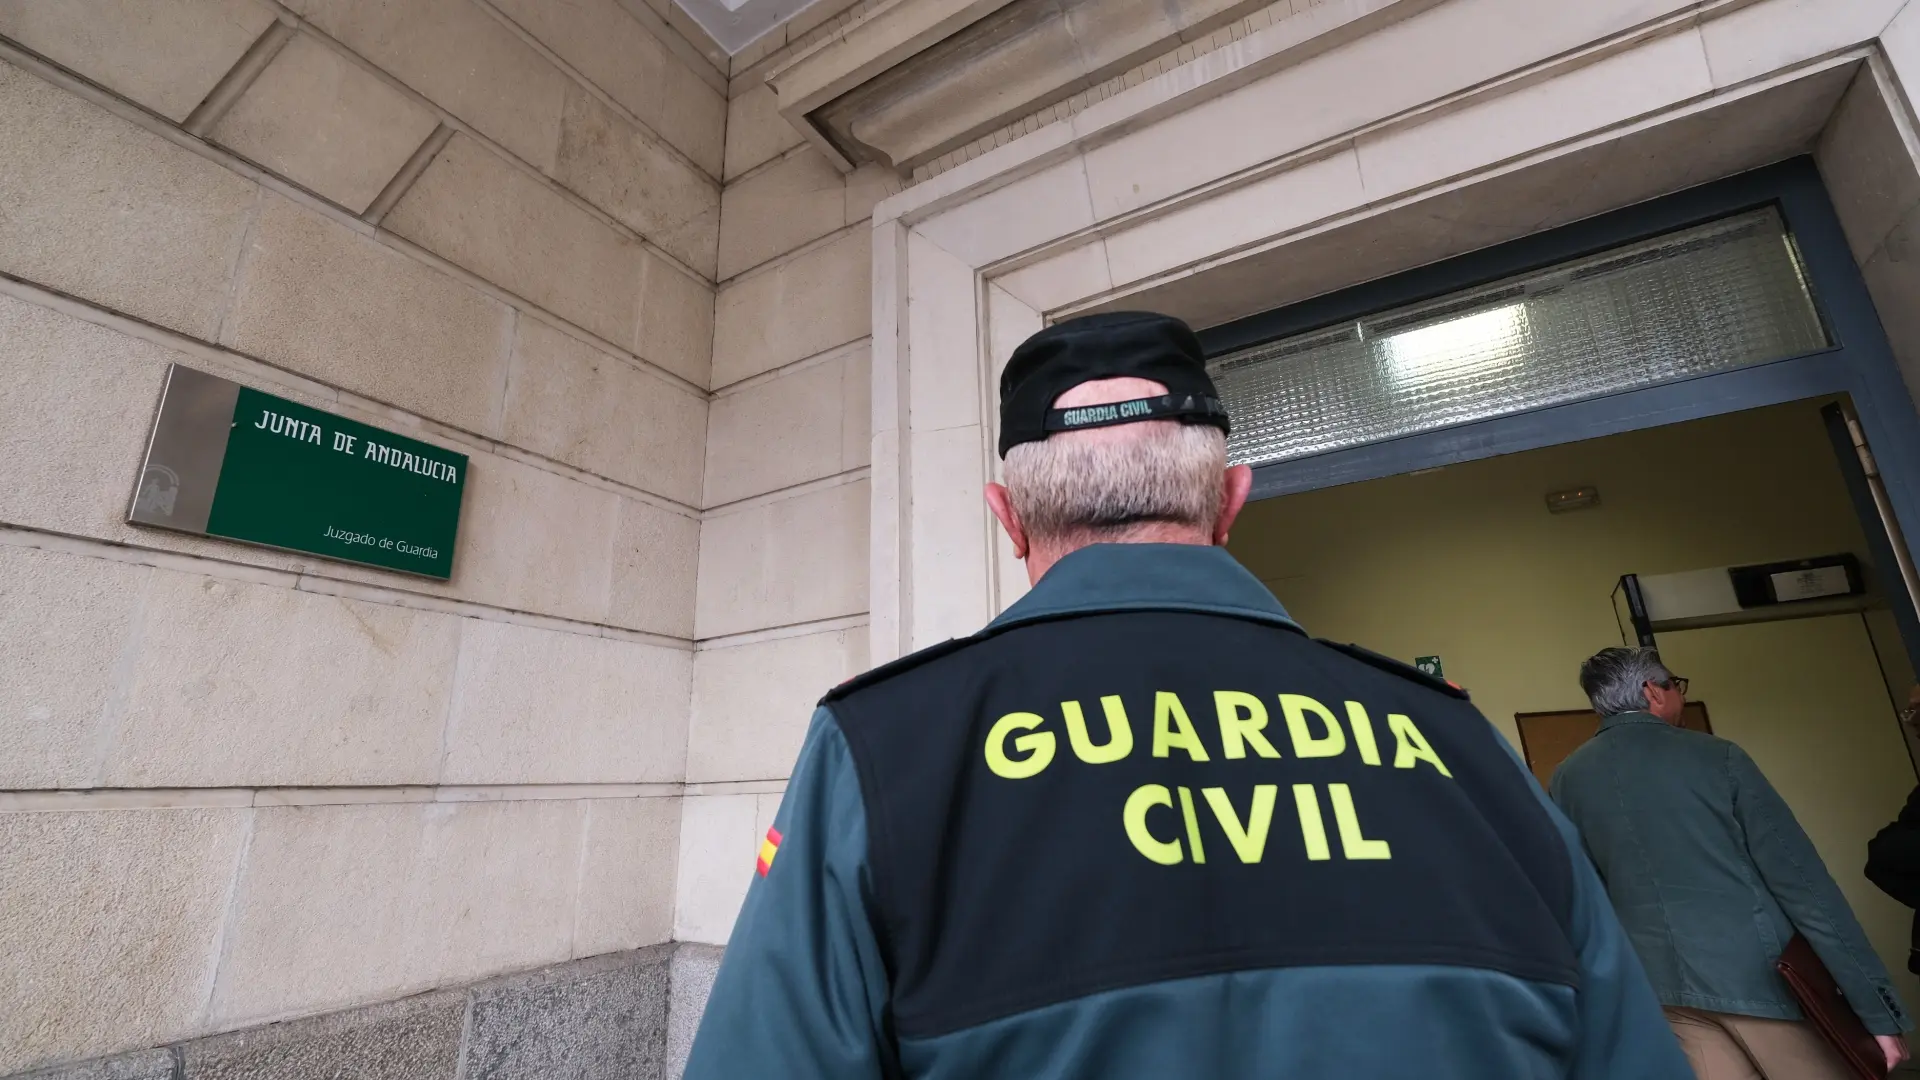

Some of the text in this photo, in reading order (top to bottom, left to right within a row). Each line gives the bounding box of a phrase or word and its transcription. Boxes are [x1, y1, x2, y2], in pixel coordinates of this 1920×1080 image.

[254, 410, 456, 484] JUNTA DE ANDALUCIA
[1064, 400, 1153, 426] GUARDIA CIVIL
[323, 525, 438, 558] Juzgado de Guardia
[984, 690, 1453, 779] GUARDIA
[1123, 783, 1392, 865] CIVIL
